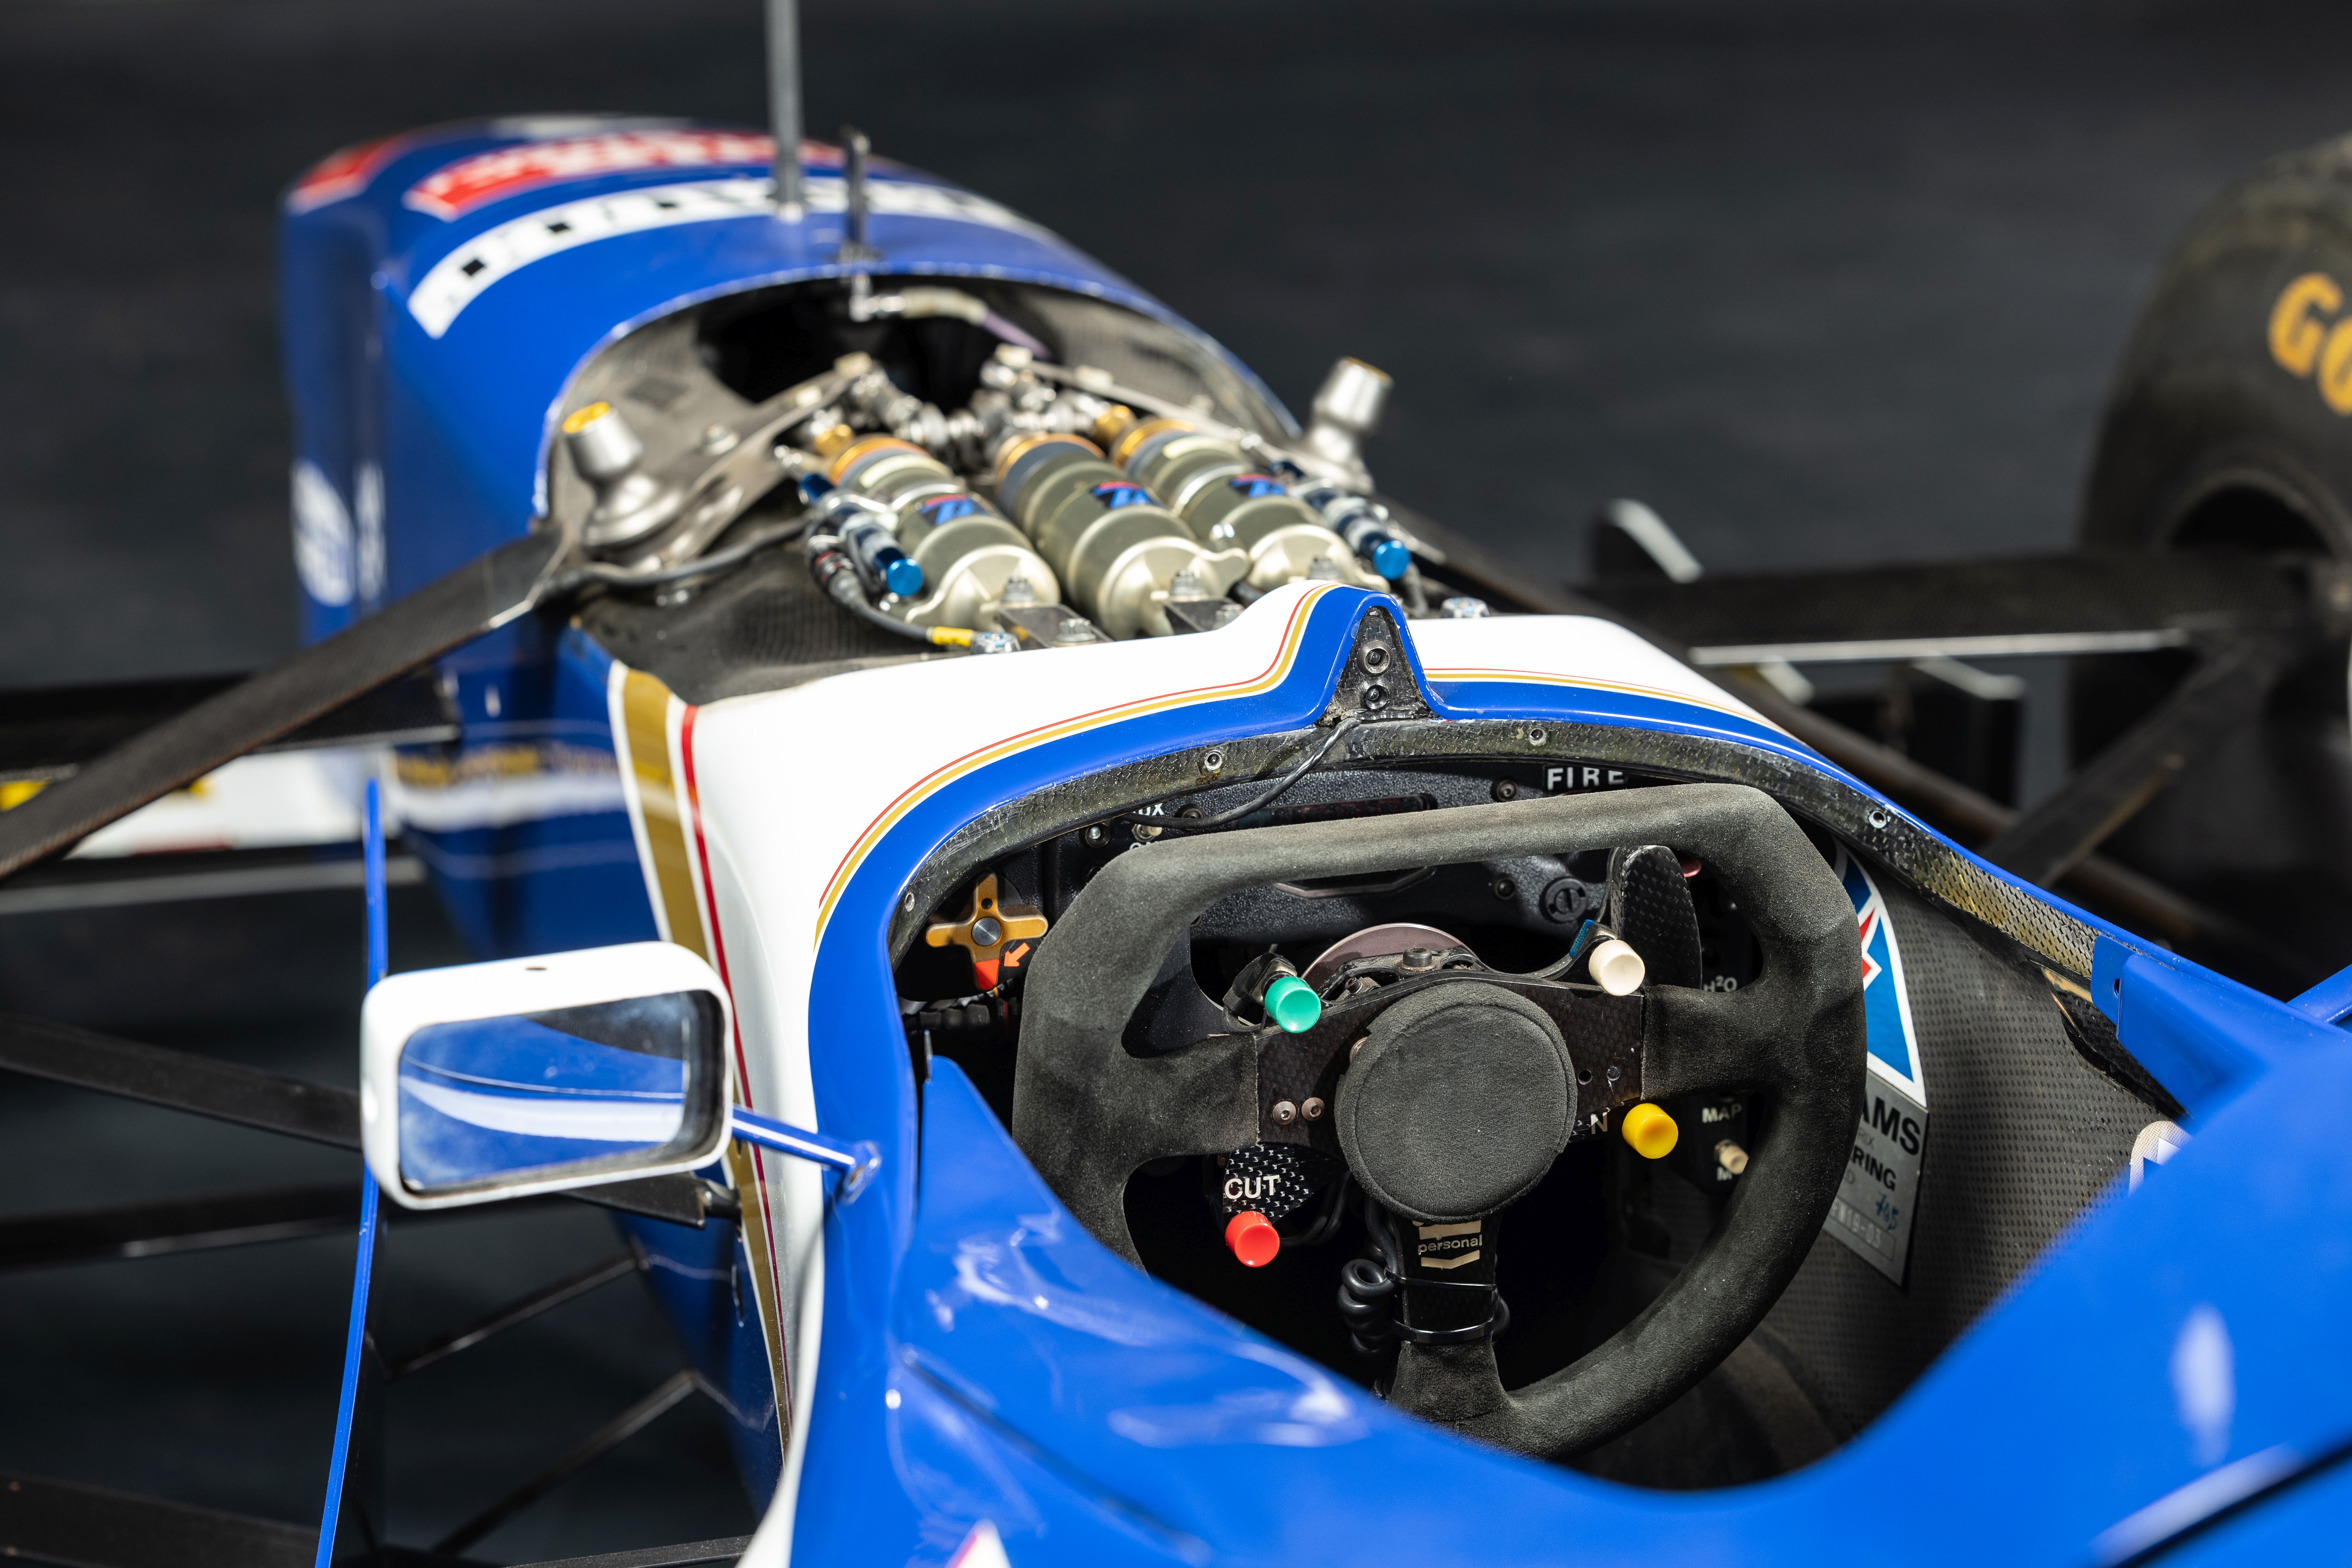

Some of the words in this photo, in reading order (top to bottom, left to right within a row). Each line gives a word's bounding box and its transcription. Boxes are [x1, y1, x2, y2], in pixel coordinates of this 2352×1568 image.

[1547, 766, 1624, 791] FIRE
[1132, 803, 1165, 816] UX
[1590, 1112, 1608, 1135] N
[1702, 1103, 1742, 1123] MAP
[1224, 1174, 1280, 1200] CUT
[1417, 1234, 1483, 1255] personal
